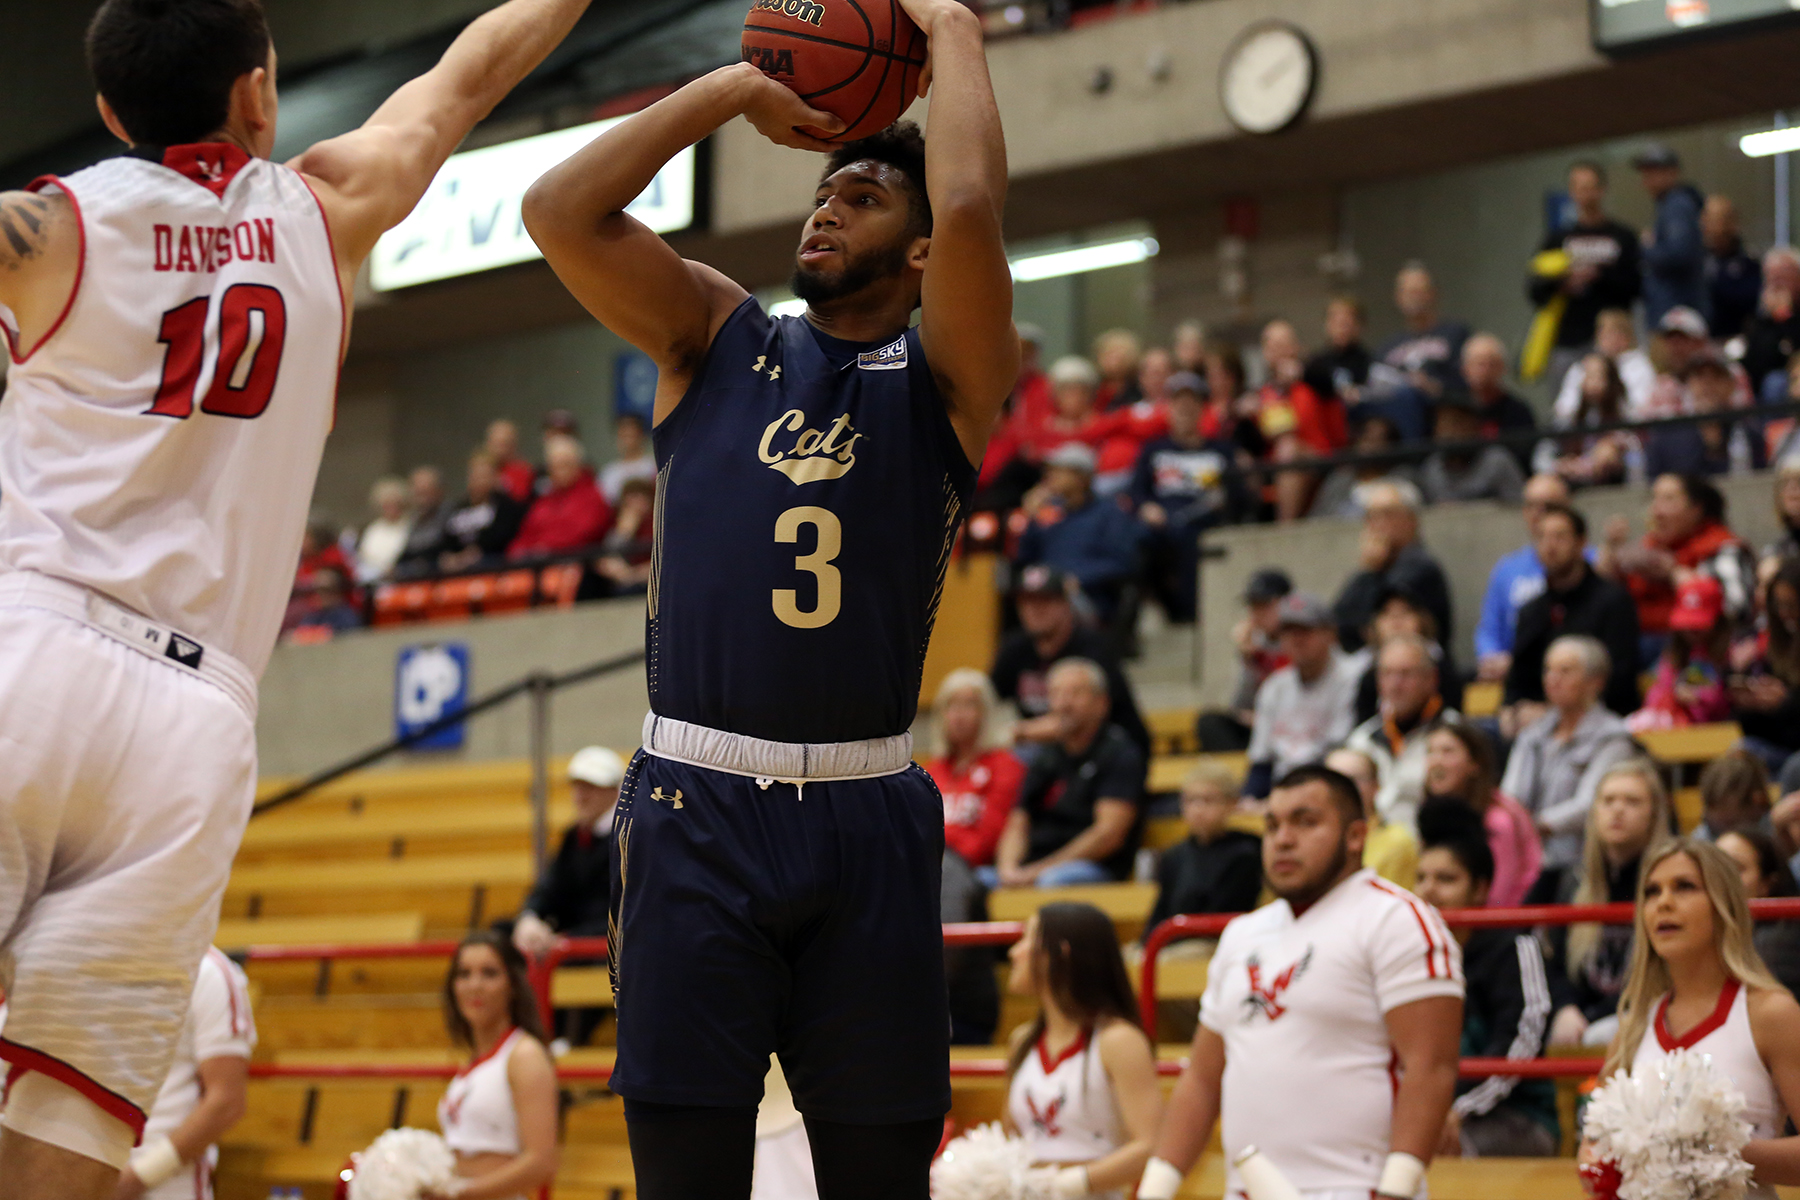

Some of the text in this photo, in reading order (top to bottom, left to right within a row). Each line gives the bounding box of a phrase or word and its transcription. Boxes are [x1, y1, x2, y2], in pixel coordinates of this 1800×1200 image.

[749, 0, 826, 27] son
[140, 282, 288, 420] 10
[757, 408, 863, 465] Cats
[771, 505, 842, 629] 3
